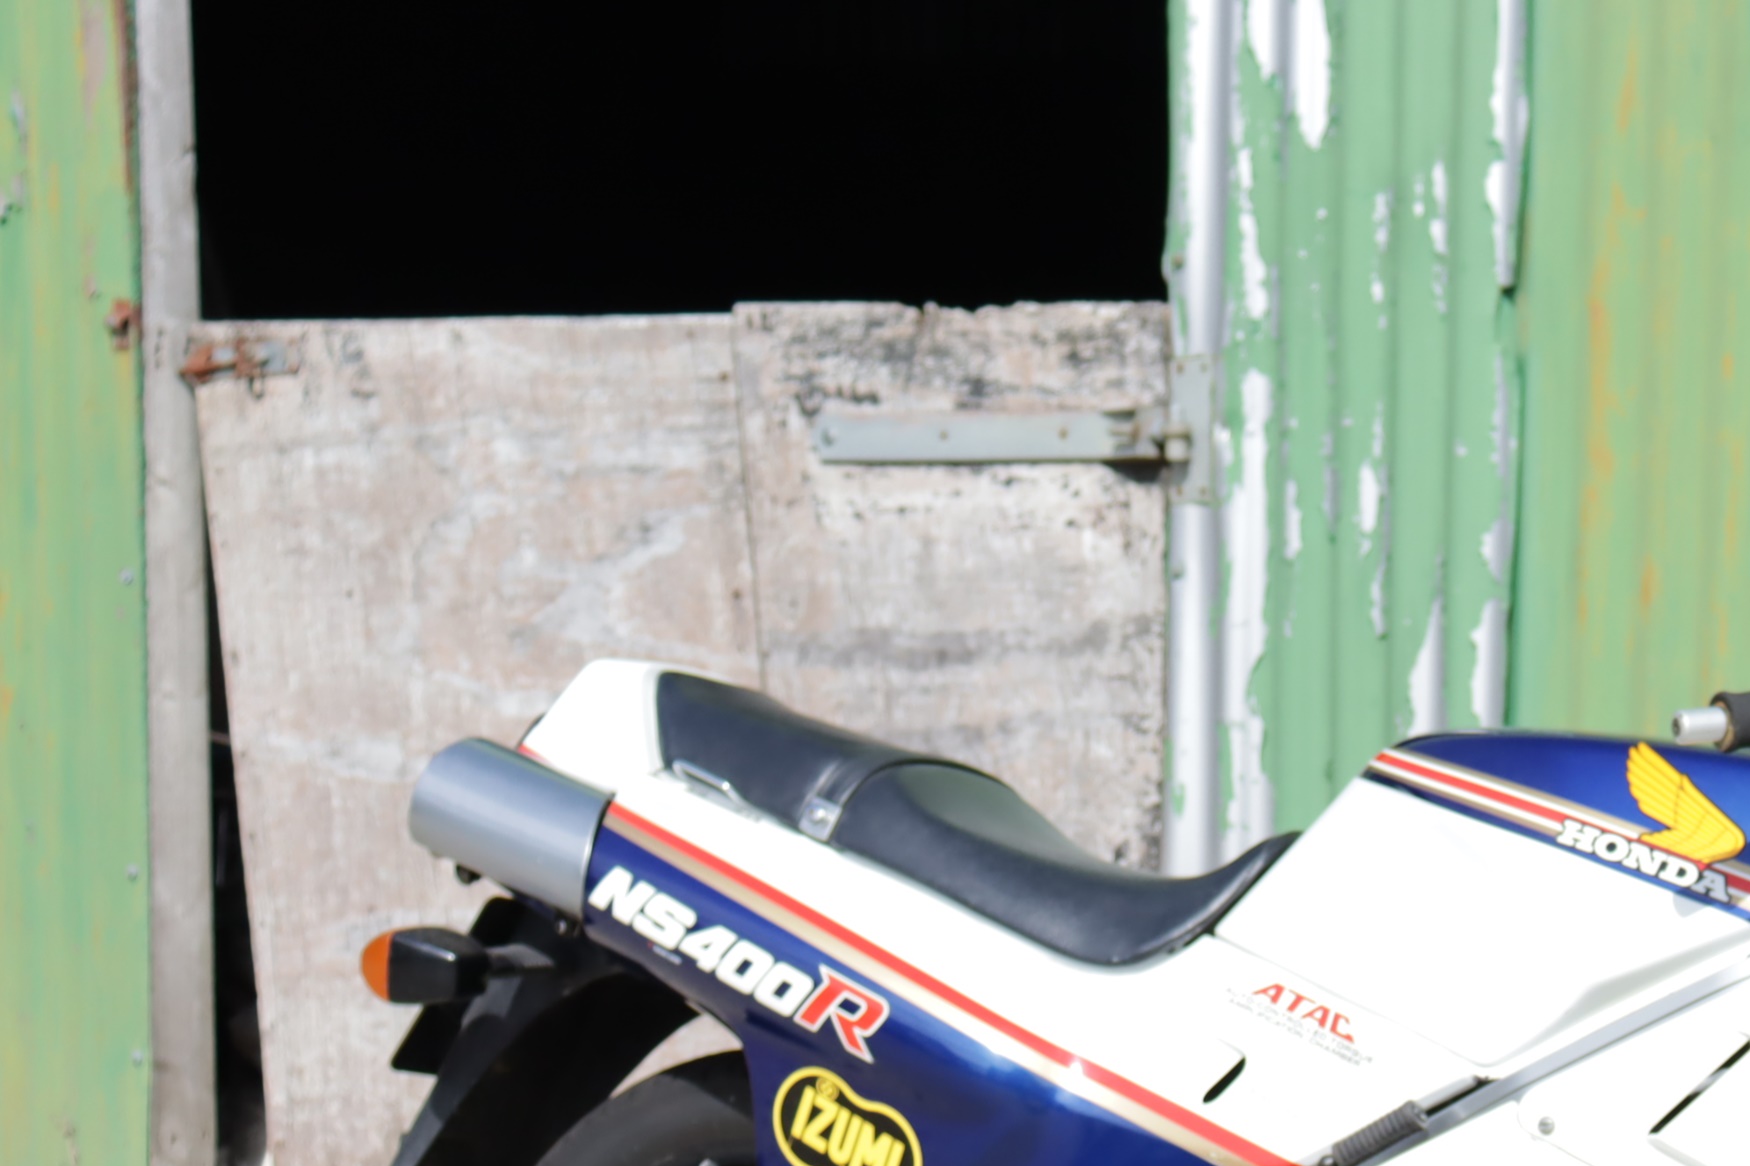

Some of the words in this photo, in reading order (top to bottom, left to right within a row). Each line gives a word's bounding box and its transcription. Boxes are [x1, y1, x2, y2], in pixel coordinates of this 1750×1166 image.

[1555, 818, 1732, 903] HONDA
[588, 865, 890, 1064] NS400R
[1250, 982, 1356, 1046] ATAC
